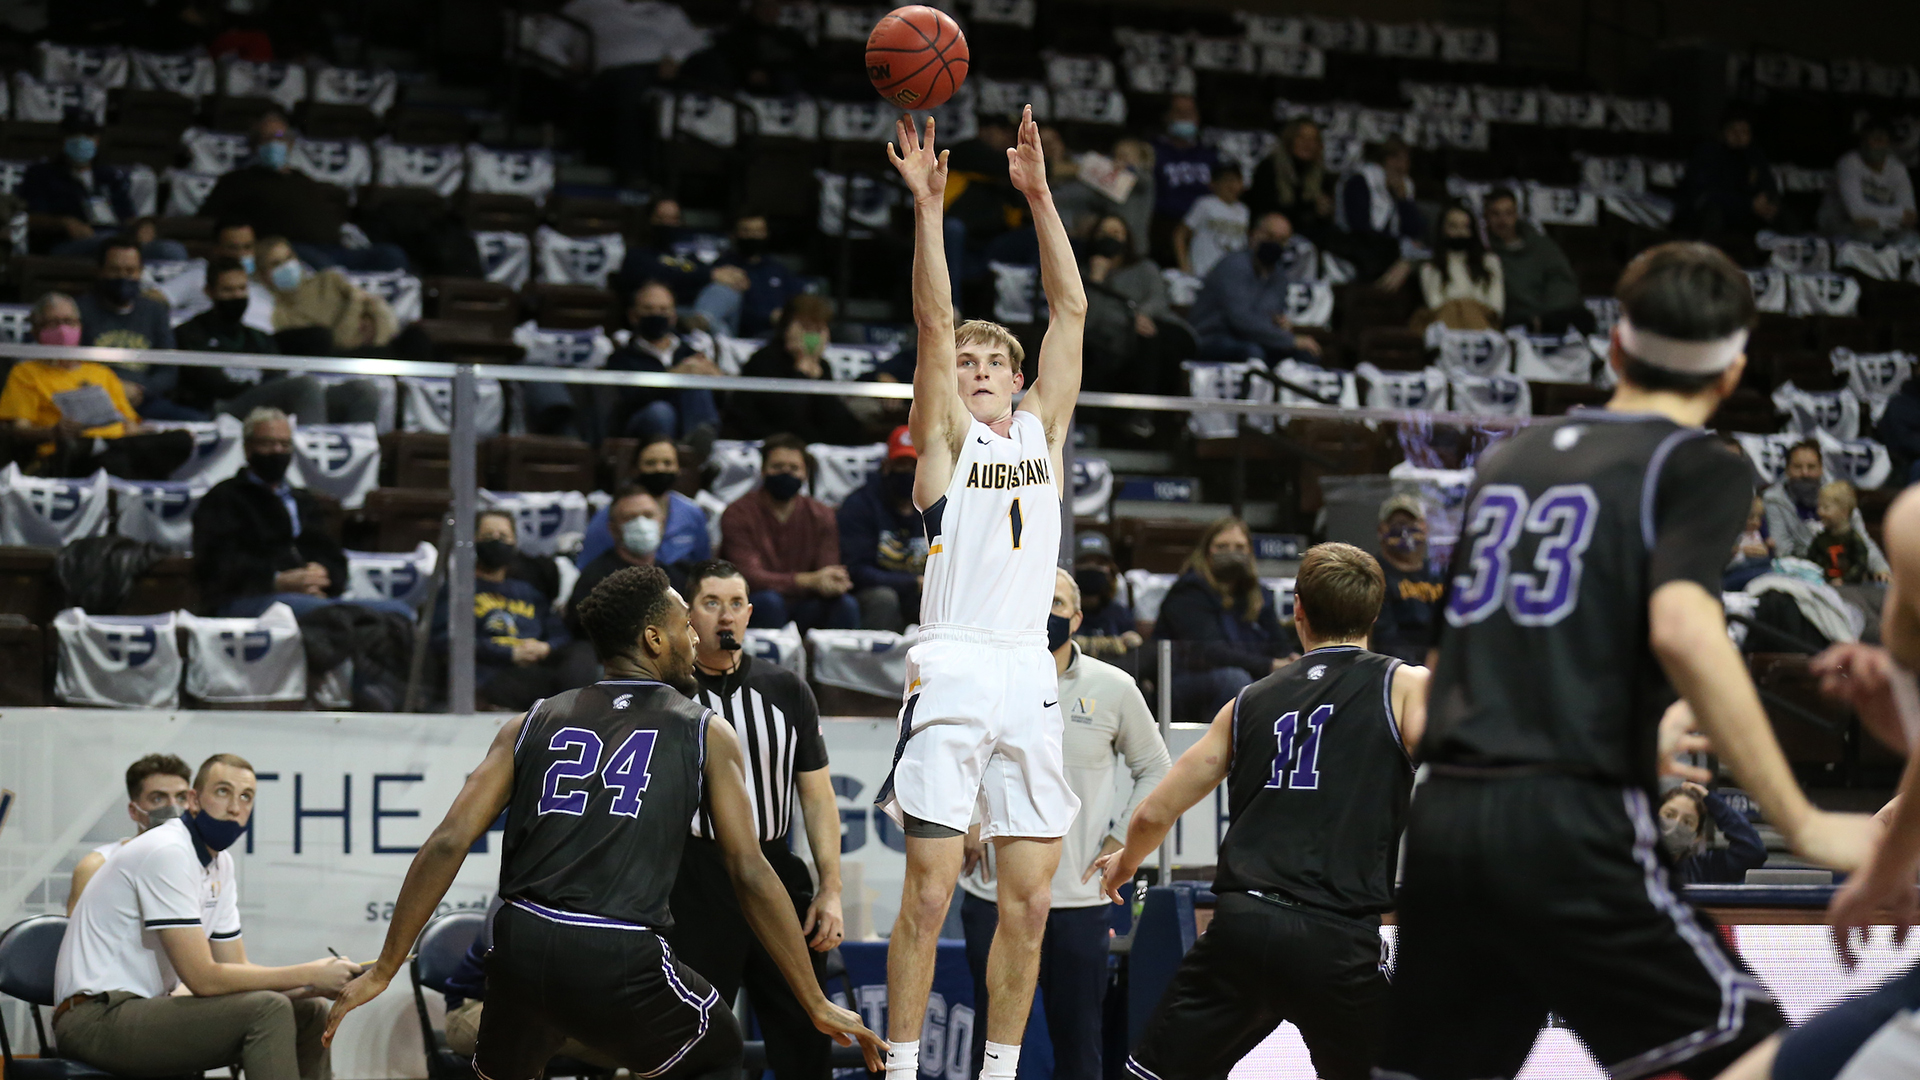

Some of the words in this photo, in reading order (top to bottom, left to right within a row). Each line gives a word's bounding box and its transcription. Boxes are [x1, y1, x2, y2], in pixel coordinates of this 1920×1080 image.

[1008, 497, 1023, 550] 1
[1444, 483, 1600, 627] 33
[537, 726, 659, 819] 24
[1264, 704, 1334, 789] 11
[366, 894, 487, 922] saord
